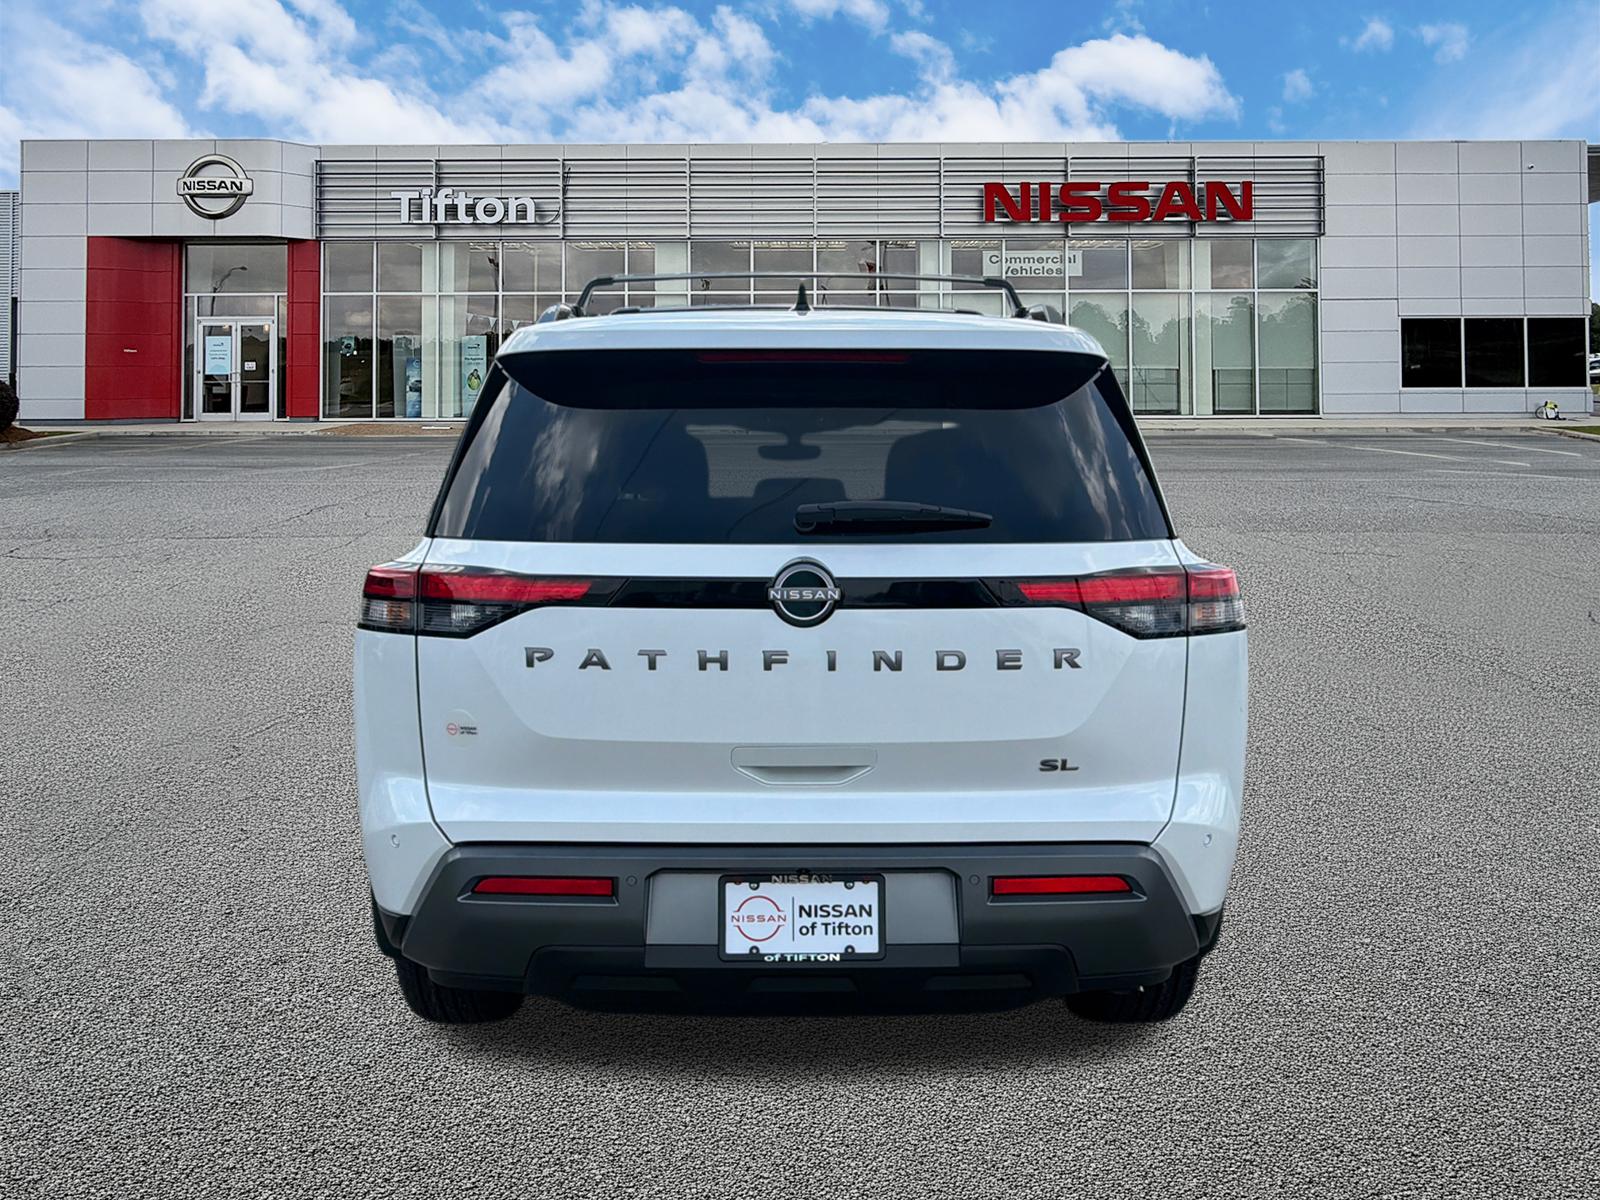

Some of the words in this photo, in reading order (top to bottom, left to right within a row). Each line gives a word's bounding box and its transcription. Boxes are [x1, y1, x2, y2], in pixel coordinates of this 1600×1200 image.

[182, 180, 243, 191] NISSAN
[390, 187, 536, 224] Tifton
[982, 181, 1254, 222] NISSAN
[769, 588, 841, 601] NISSAN
[524, 647, 1083, 671] PATHFINDER
[1038, 758, 1080, 772] SL
[771, 874, 833, 884] NISSAN
[799, 904, 873, 918] NISSAN
[731, 914, 787, 923] NISSAN
[799, 922, 817, 936] of
[821, 922, 874, 936] Tifton
[764, 952, 783, 962] of
[786, 953, 841, 962] TIFTON
